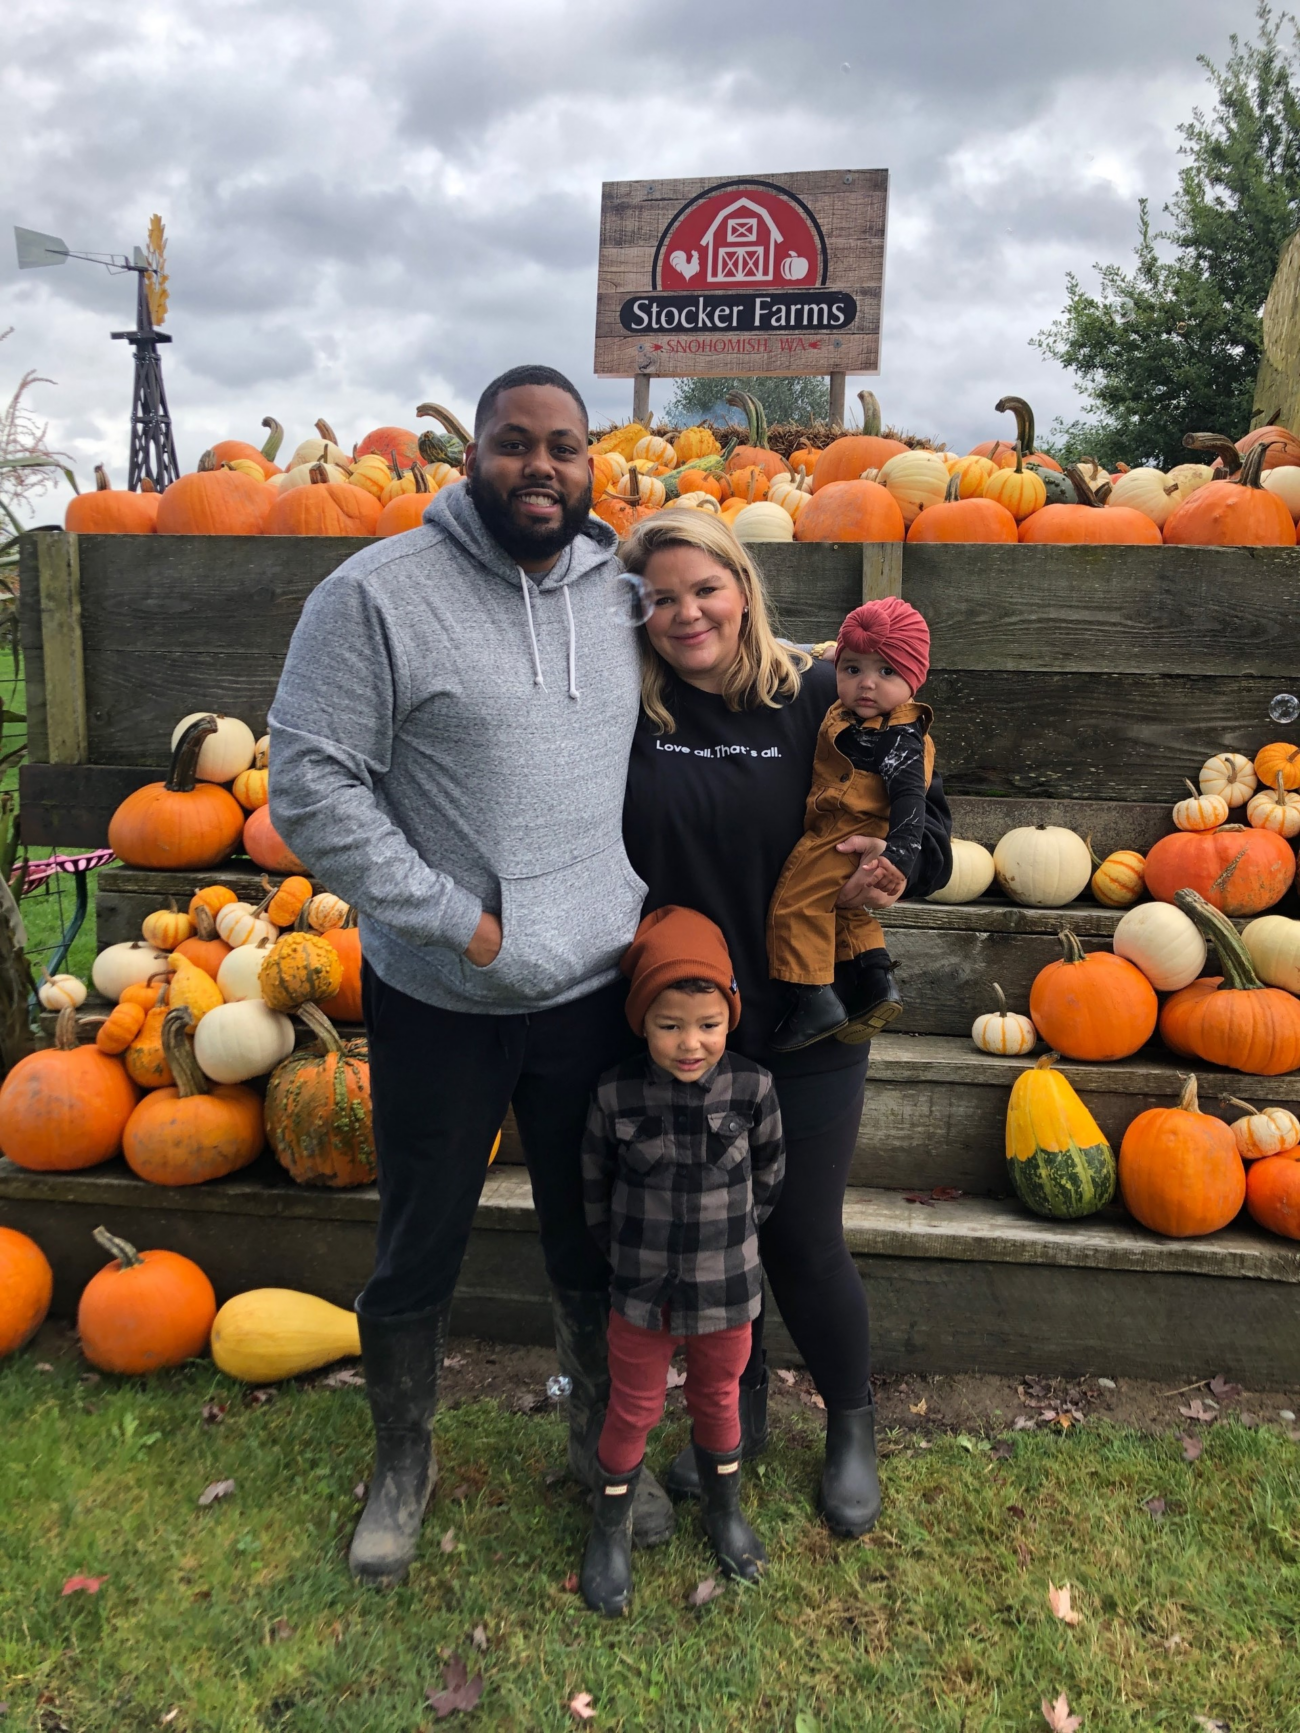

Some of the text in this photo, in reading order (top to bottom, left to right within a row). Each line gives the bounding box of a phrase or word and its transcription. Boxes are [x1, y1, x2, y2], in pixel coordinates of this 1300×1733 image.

[631, 297, 845, 329] Stocker Farms
[779, 337, 807, 353] WA
[656, 740, 782, 758] Love all. That's all.
